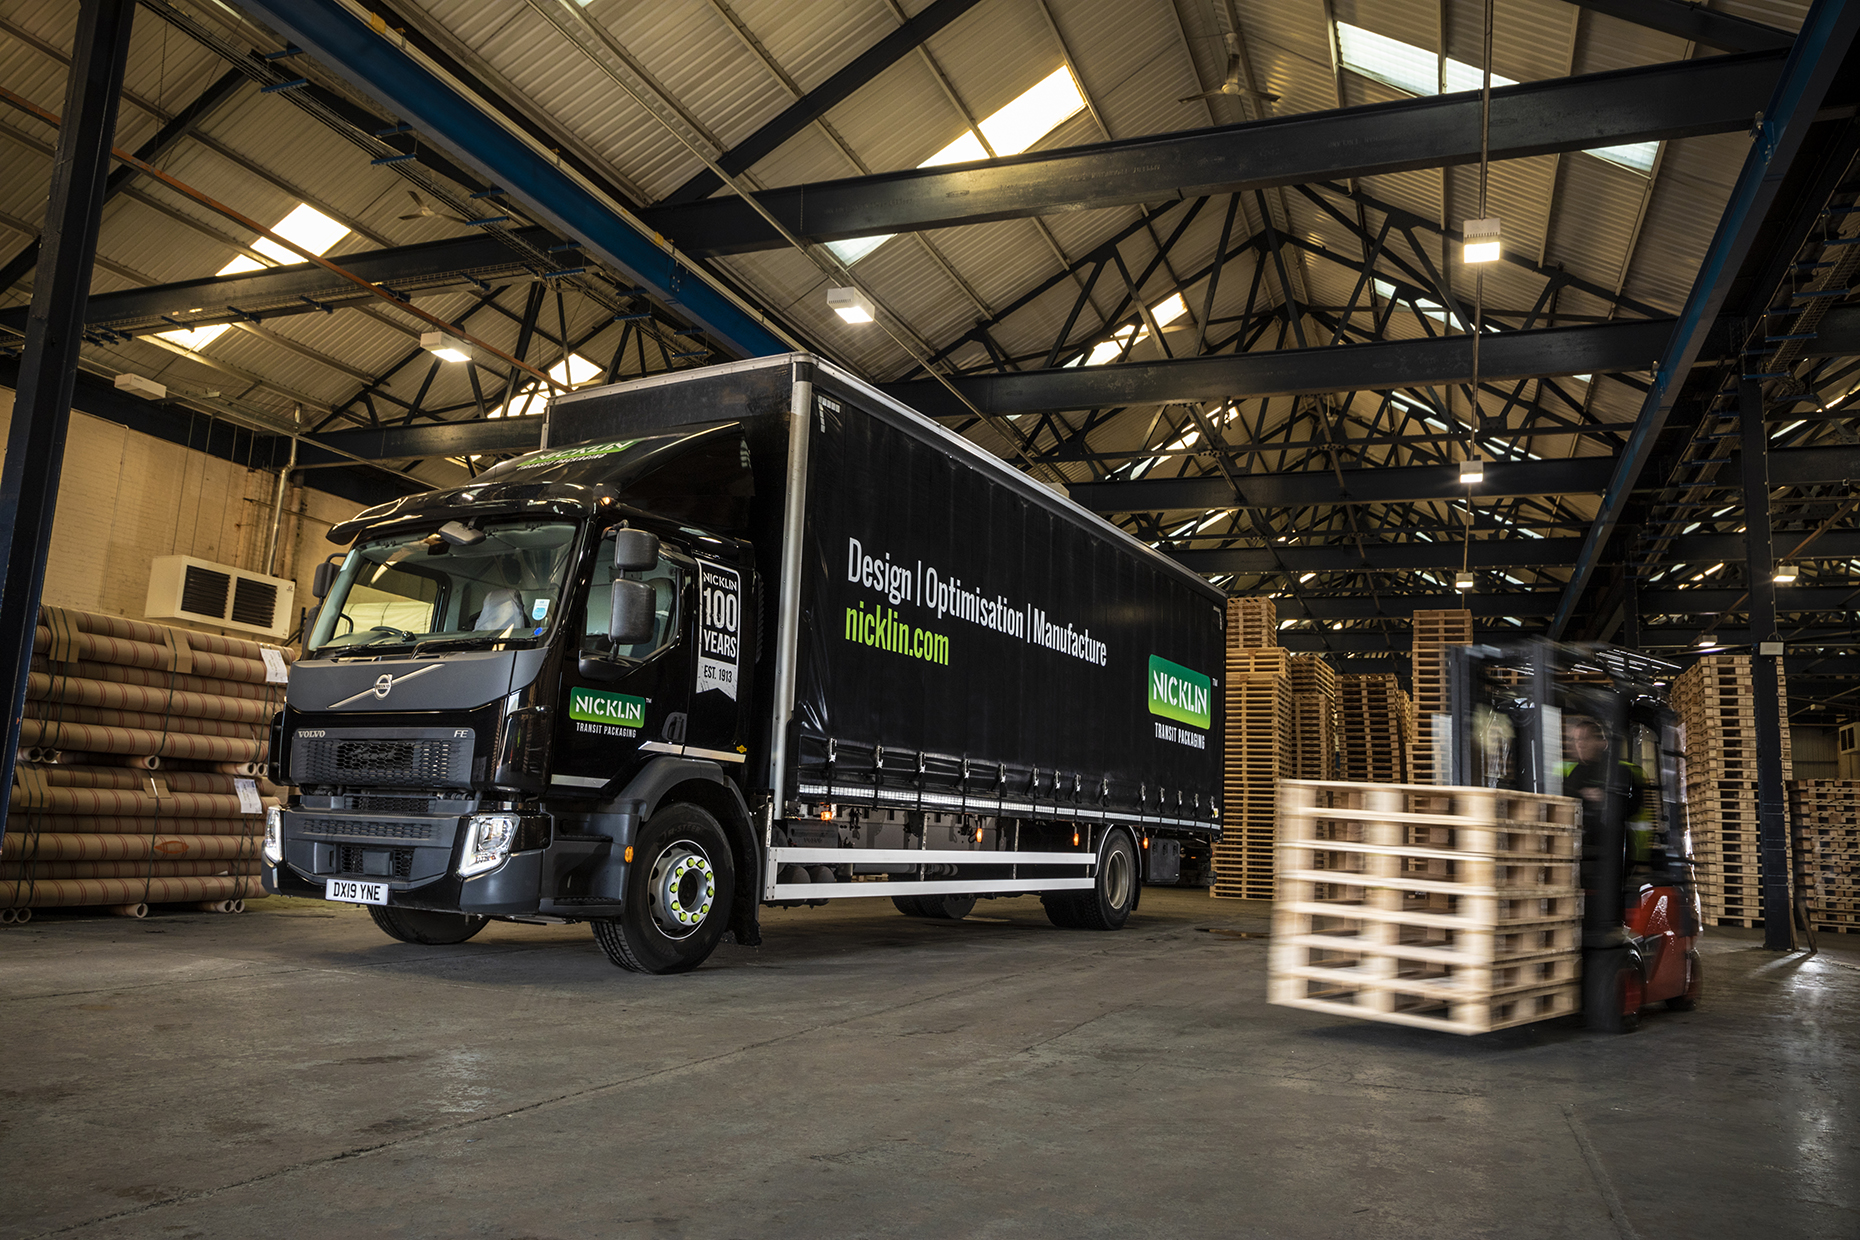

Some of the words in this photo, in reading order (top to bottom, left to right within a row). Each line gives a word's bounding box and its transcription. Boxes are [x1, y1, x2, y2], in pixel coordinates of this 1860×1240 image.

[703, 571, 738, 591] NICKLIN
[703, 587, 738, 632] 100
[848, 536, 912, 605] Design
[925, 566, 1024, 639] Optimisation
[1033, 607, 1107, 667] Manufacture
[703, 629, 737, 658] YEARS
[845, 600, 950, 666] nicklin.com
[703, 664, 717, 680] EST.
[719, 668, 733, 683] 1913
[1153, 669, 1208, 716] NICKLIN
[575, 694, 641, 721] NICKLIN
[298, 730, 326, 738] VOLVO
[453, 729, 469, 738] FE
[576, 722, 603, 734] TRANSIT
[603, 725, 637, 739] PACKAGING
[1154, 721, 1177, 743] TRANSIT
[1178, 728, 1206, 750] PACKAGING
[333, 881, 357, 899] DX19
[360, 884, 381, 901] YNE
